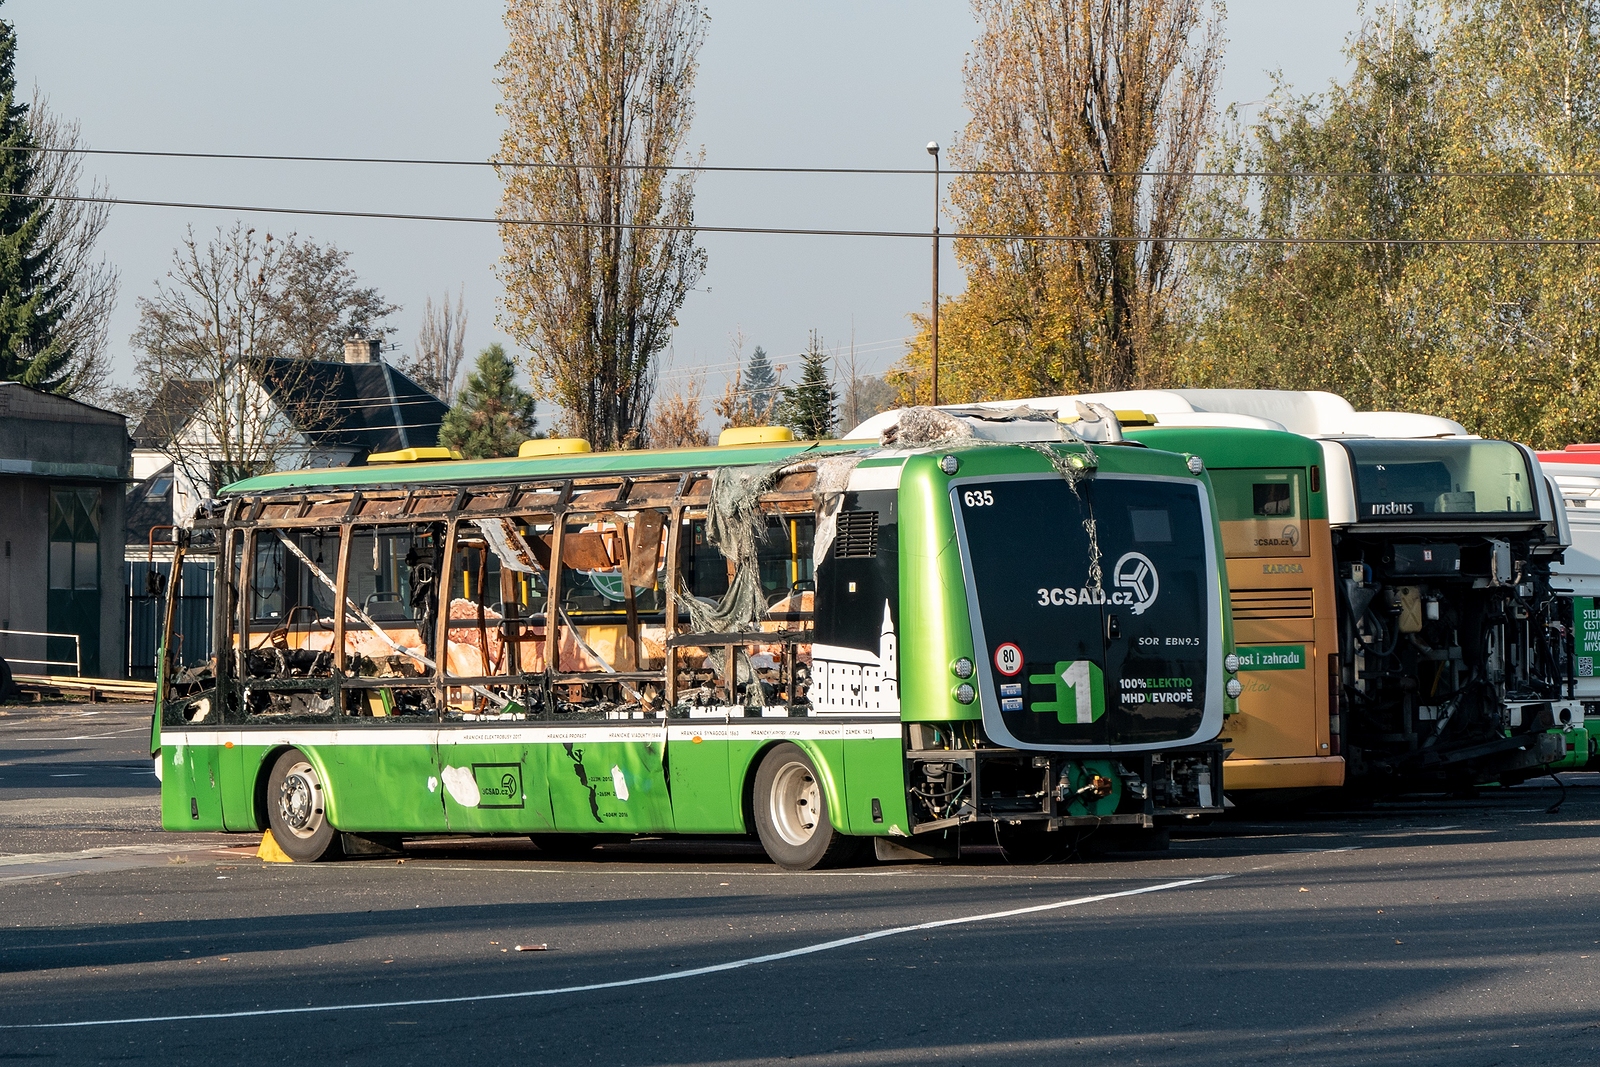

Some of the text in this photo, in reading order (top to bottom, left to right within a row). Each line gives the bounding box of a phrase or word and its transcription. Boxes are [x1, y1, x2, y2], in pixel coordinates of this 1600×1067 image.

[964, 490, 994, 507] 635
[1263, 564, 1303, 574] KAROSA
[1037, 587, 1133, 606] 3CSAD.cz
[1583, 609, 1600, 619] STEJ
[1583, 620, 1600, 630] CEST
[1138, 637, 1200, 646] SOR EBN9.5
[1584, 640, 1600, 652] MYŠ
[1003, 649, 1015, 663] 80
[1239, 651, 1300, 665] ost i zahradu
[1061, 660, 1093, 724] 1
